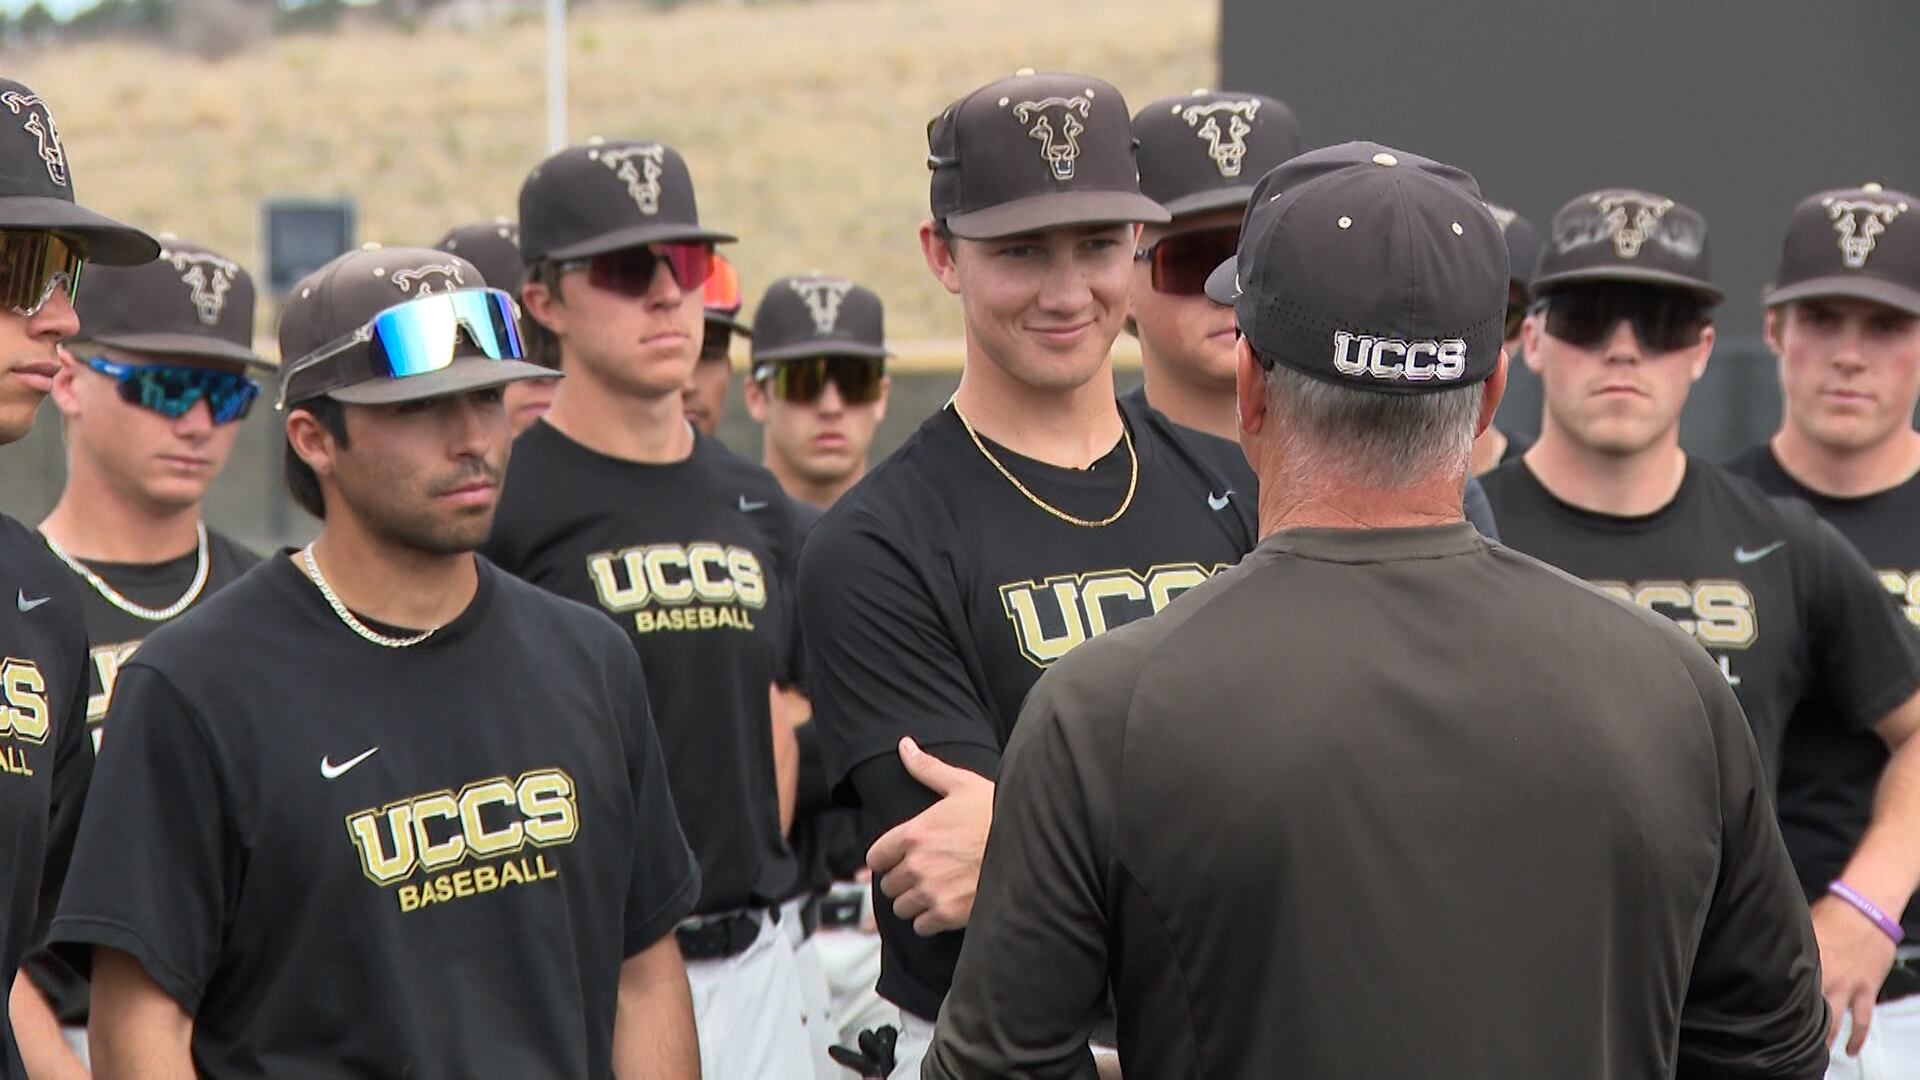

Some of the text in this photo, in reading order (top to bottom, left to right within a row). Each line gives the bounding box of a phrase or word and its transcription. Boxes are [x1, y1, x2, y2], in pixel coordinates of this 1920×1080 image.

[1334, 330, 1466, 380] UCCS
[587, 541, 767, 614] UCCS
[635, 606, 754, 633] BASEBALL
[999, 562, 1238, 668] UC
[346, 768, 580, 887] UCCS
[399, 855, 557, 913] BASEBALL
